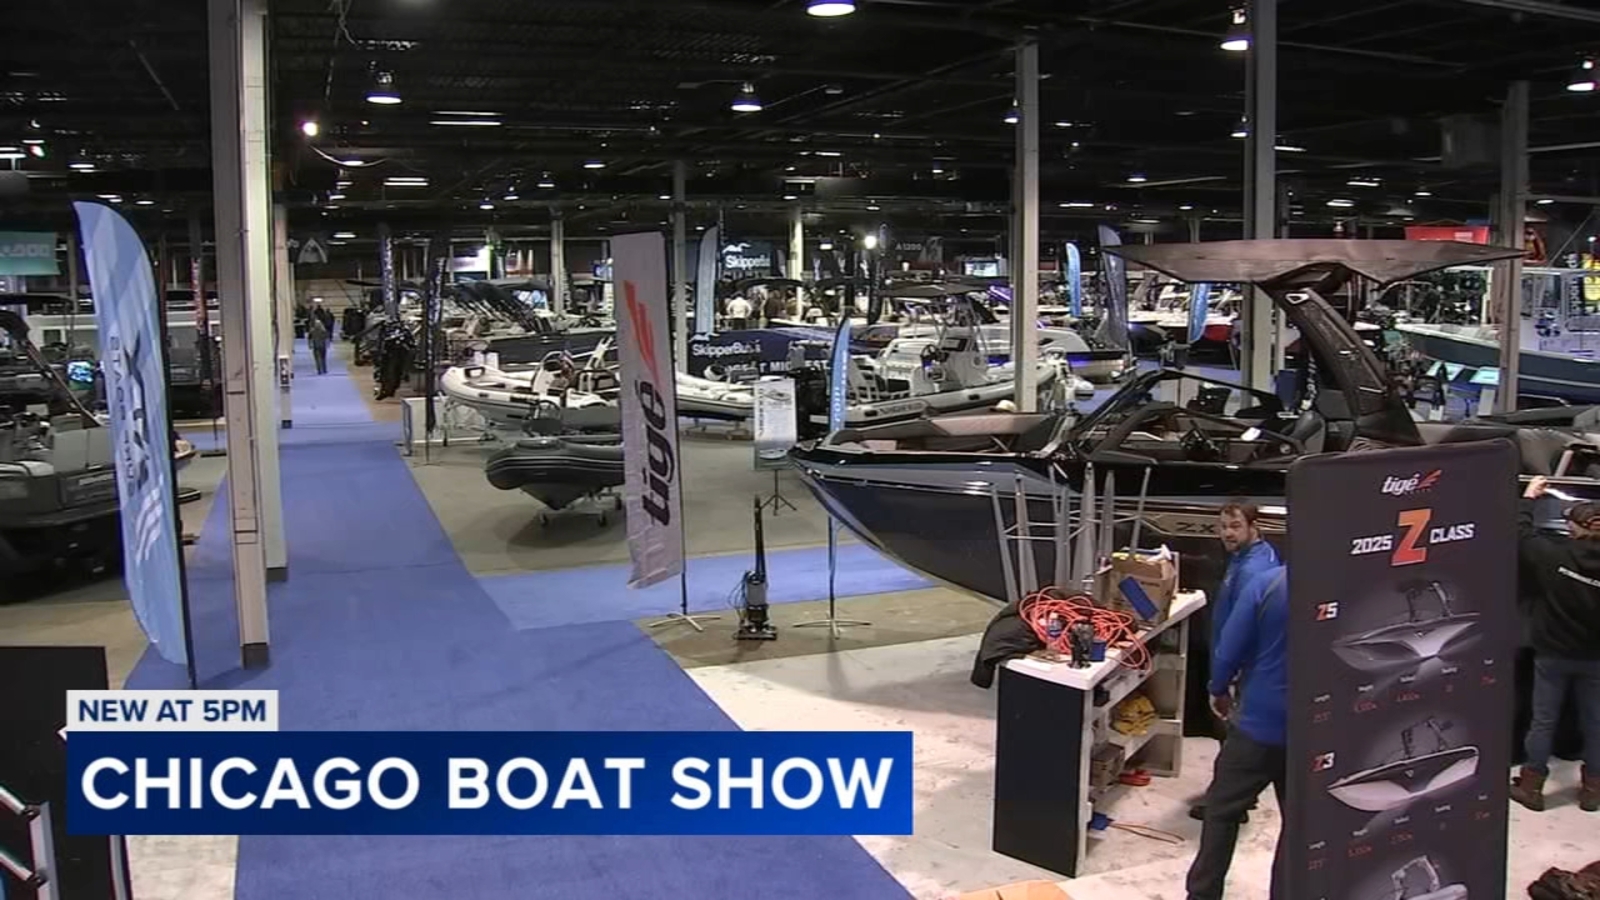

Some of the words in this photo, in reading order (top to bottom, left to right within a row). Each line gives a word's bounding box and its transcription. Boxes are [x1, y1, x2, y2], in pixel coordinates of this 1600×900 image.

[1381, 473, 1421, 496] tigé
[1351, 534, 1394, 555] 2025
[1390, 508, 1432, 566] Z
[1430, 523, 1475, 544] CLASS
[1316, 602, 1338, 621] Z5
[1312, 753, 1335, 771] Z3
